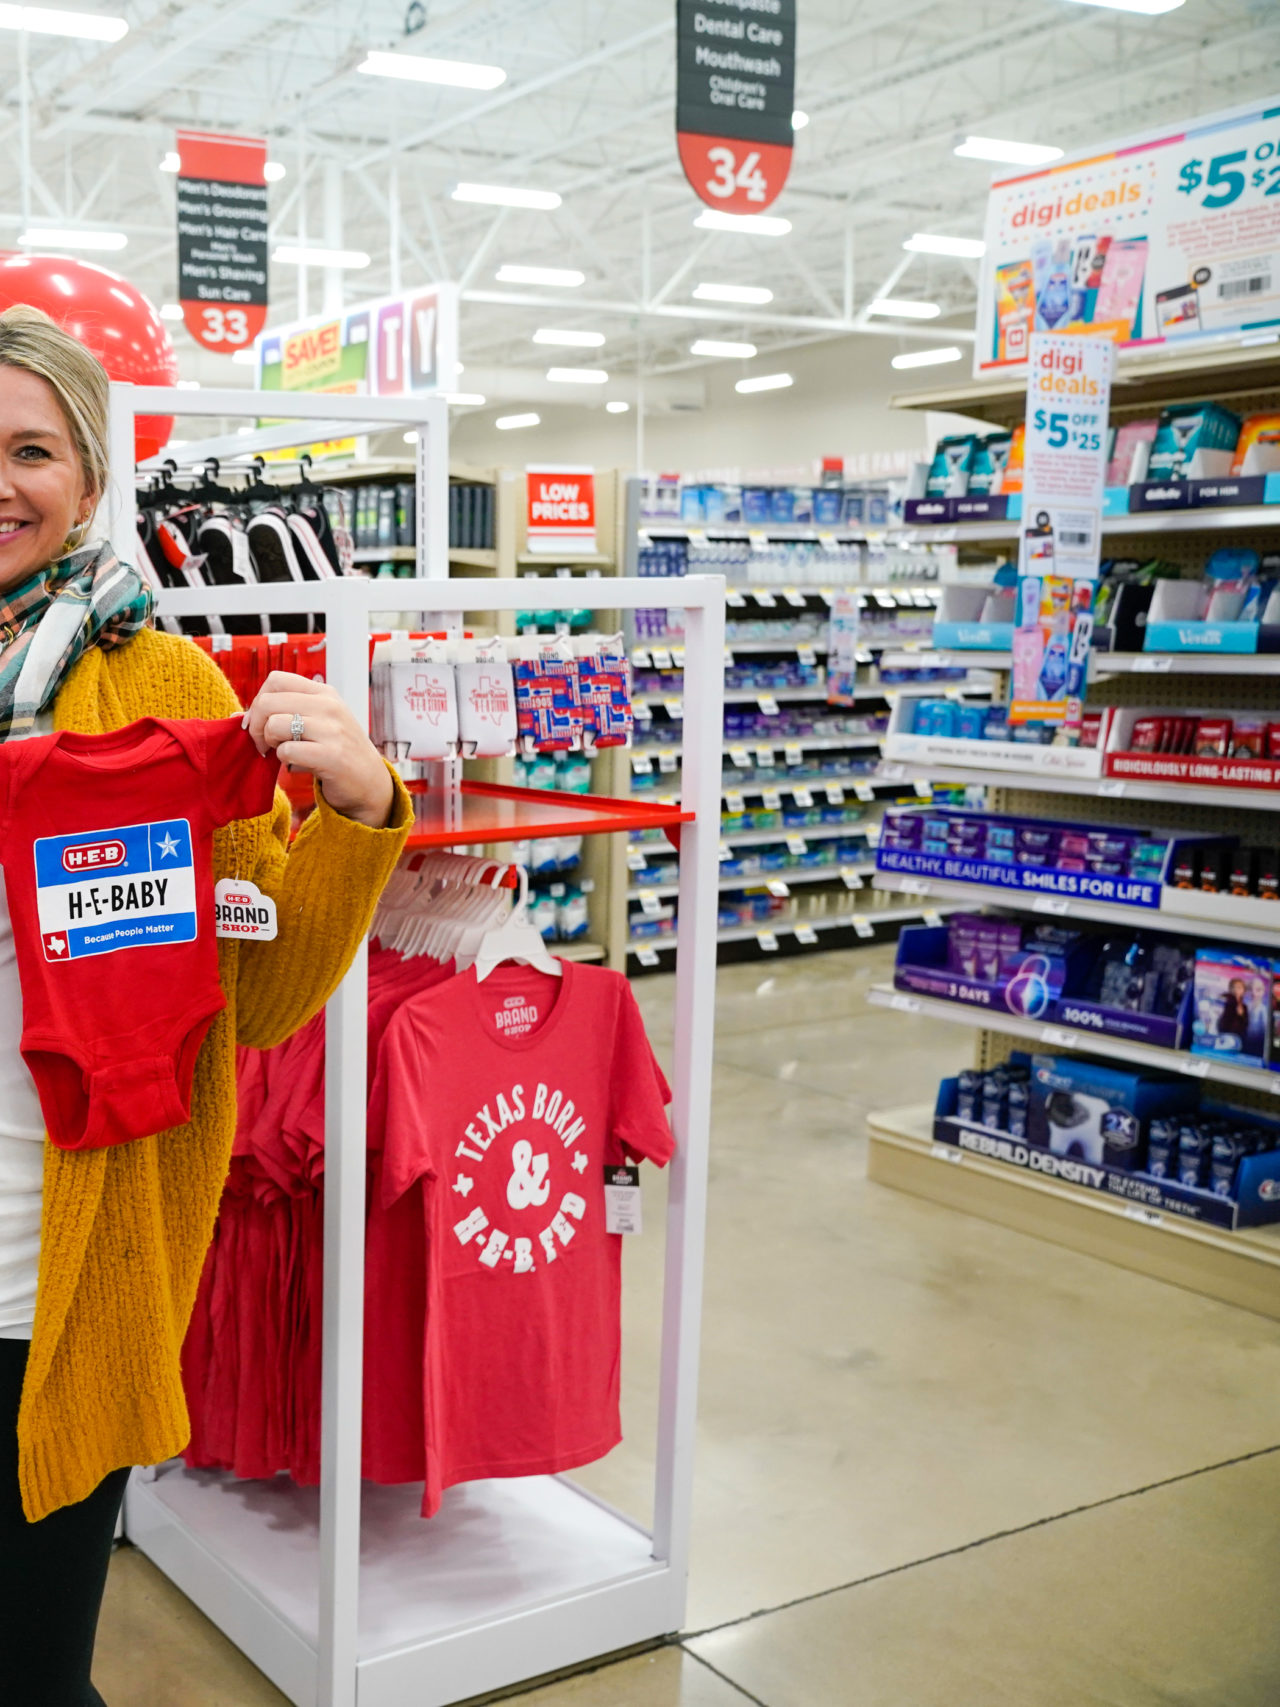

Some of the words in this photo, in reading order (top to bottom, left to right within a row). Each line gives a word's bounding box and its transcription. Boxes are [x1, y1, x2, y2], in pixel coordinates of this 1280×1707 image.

[694, 13, 744, 39] Dental
[747, 23, 783, 46] Care
[695, 46, 781, 77] Mouthwash
[709, 74, 767, 97] Children's
[710, 89, 736, 106] Oral
[738, 92, 765, 110] Care
[706, 147, 767, 202] 34
[1177, 150, 1248, 209] $5
[178, 180, 210, 196] Men's
[178, 201, 211, 216] Men's
[212, 203, 267, 223] Grooming
[179, 222, 213, 238] Men's
[214, 225, 239, 239] Hair
[240, 226, 267, 242] Care
[182, 263, 217, 279] Men's
[218, 265, 266, 285] Shaving
[198, 284, 221, 299] Sun
[222, 286, 251, 301] Care
[202, 308, 249, 344] 33
[285, 325, 340, 370] SAVE!
[1040, 349, 1082, 375] digi
[1039, 373, 1098, 396] deals
[1034, 409, 1069, 448] $5
[1072, 414, 1098, 426] OFF
[1072, 432, 1100, 451] $25
[539, 483, 580, 502] LOW
[532, 503, 589, 521] PRICES
[1114, 759, 1187, 777] RIDICULOUSLY
[1189, 763, 1272, 782] LONG-LASTING
[68, 847, 119, 865] H-E-B
[881, 853, 942, 876] HEALTHY,
[944, 861, 1018, 885] BEAUTIFUL
[1022, 871, 1077, 892] SMILES
[1080, 879, 1114, 897] FOR
[1117, 883, 1153, 903] LIFE
[69, 878, 169, 919] H-E-BABY
[84, 932, 115, 944] Because
[115, 926, 143, 938] People
[146, 923, 174, 935] Matter
[222, 924, 260, 933] SHOP
[959, 985, 990, 1003] DAYS
[495, 1005, 538, 1029] BRAND
[1063, 1008, 1104, 1028] 100%
[455, 1084, 525, 1162] TEXAS
[532, 1082, 587, 1149] BORN
[1105, 1113, 1133, 1134] 2X
[959, 1130, 1029, 1166] REBUILD
[1029, 1151, 1106, 1188] DENSITY
[507, 1139, 551, 1210] &
[538, 1191, 587, 1264] FED
